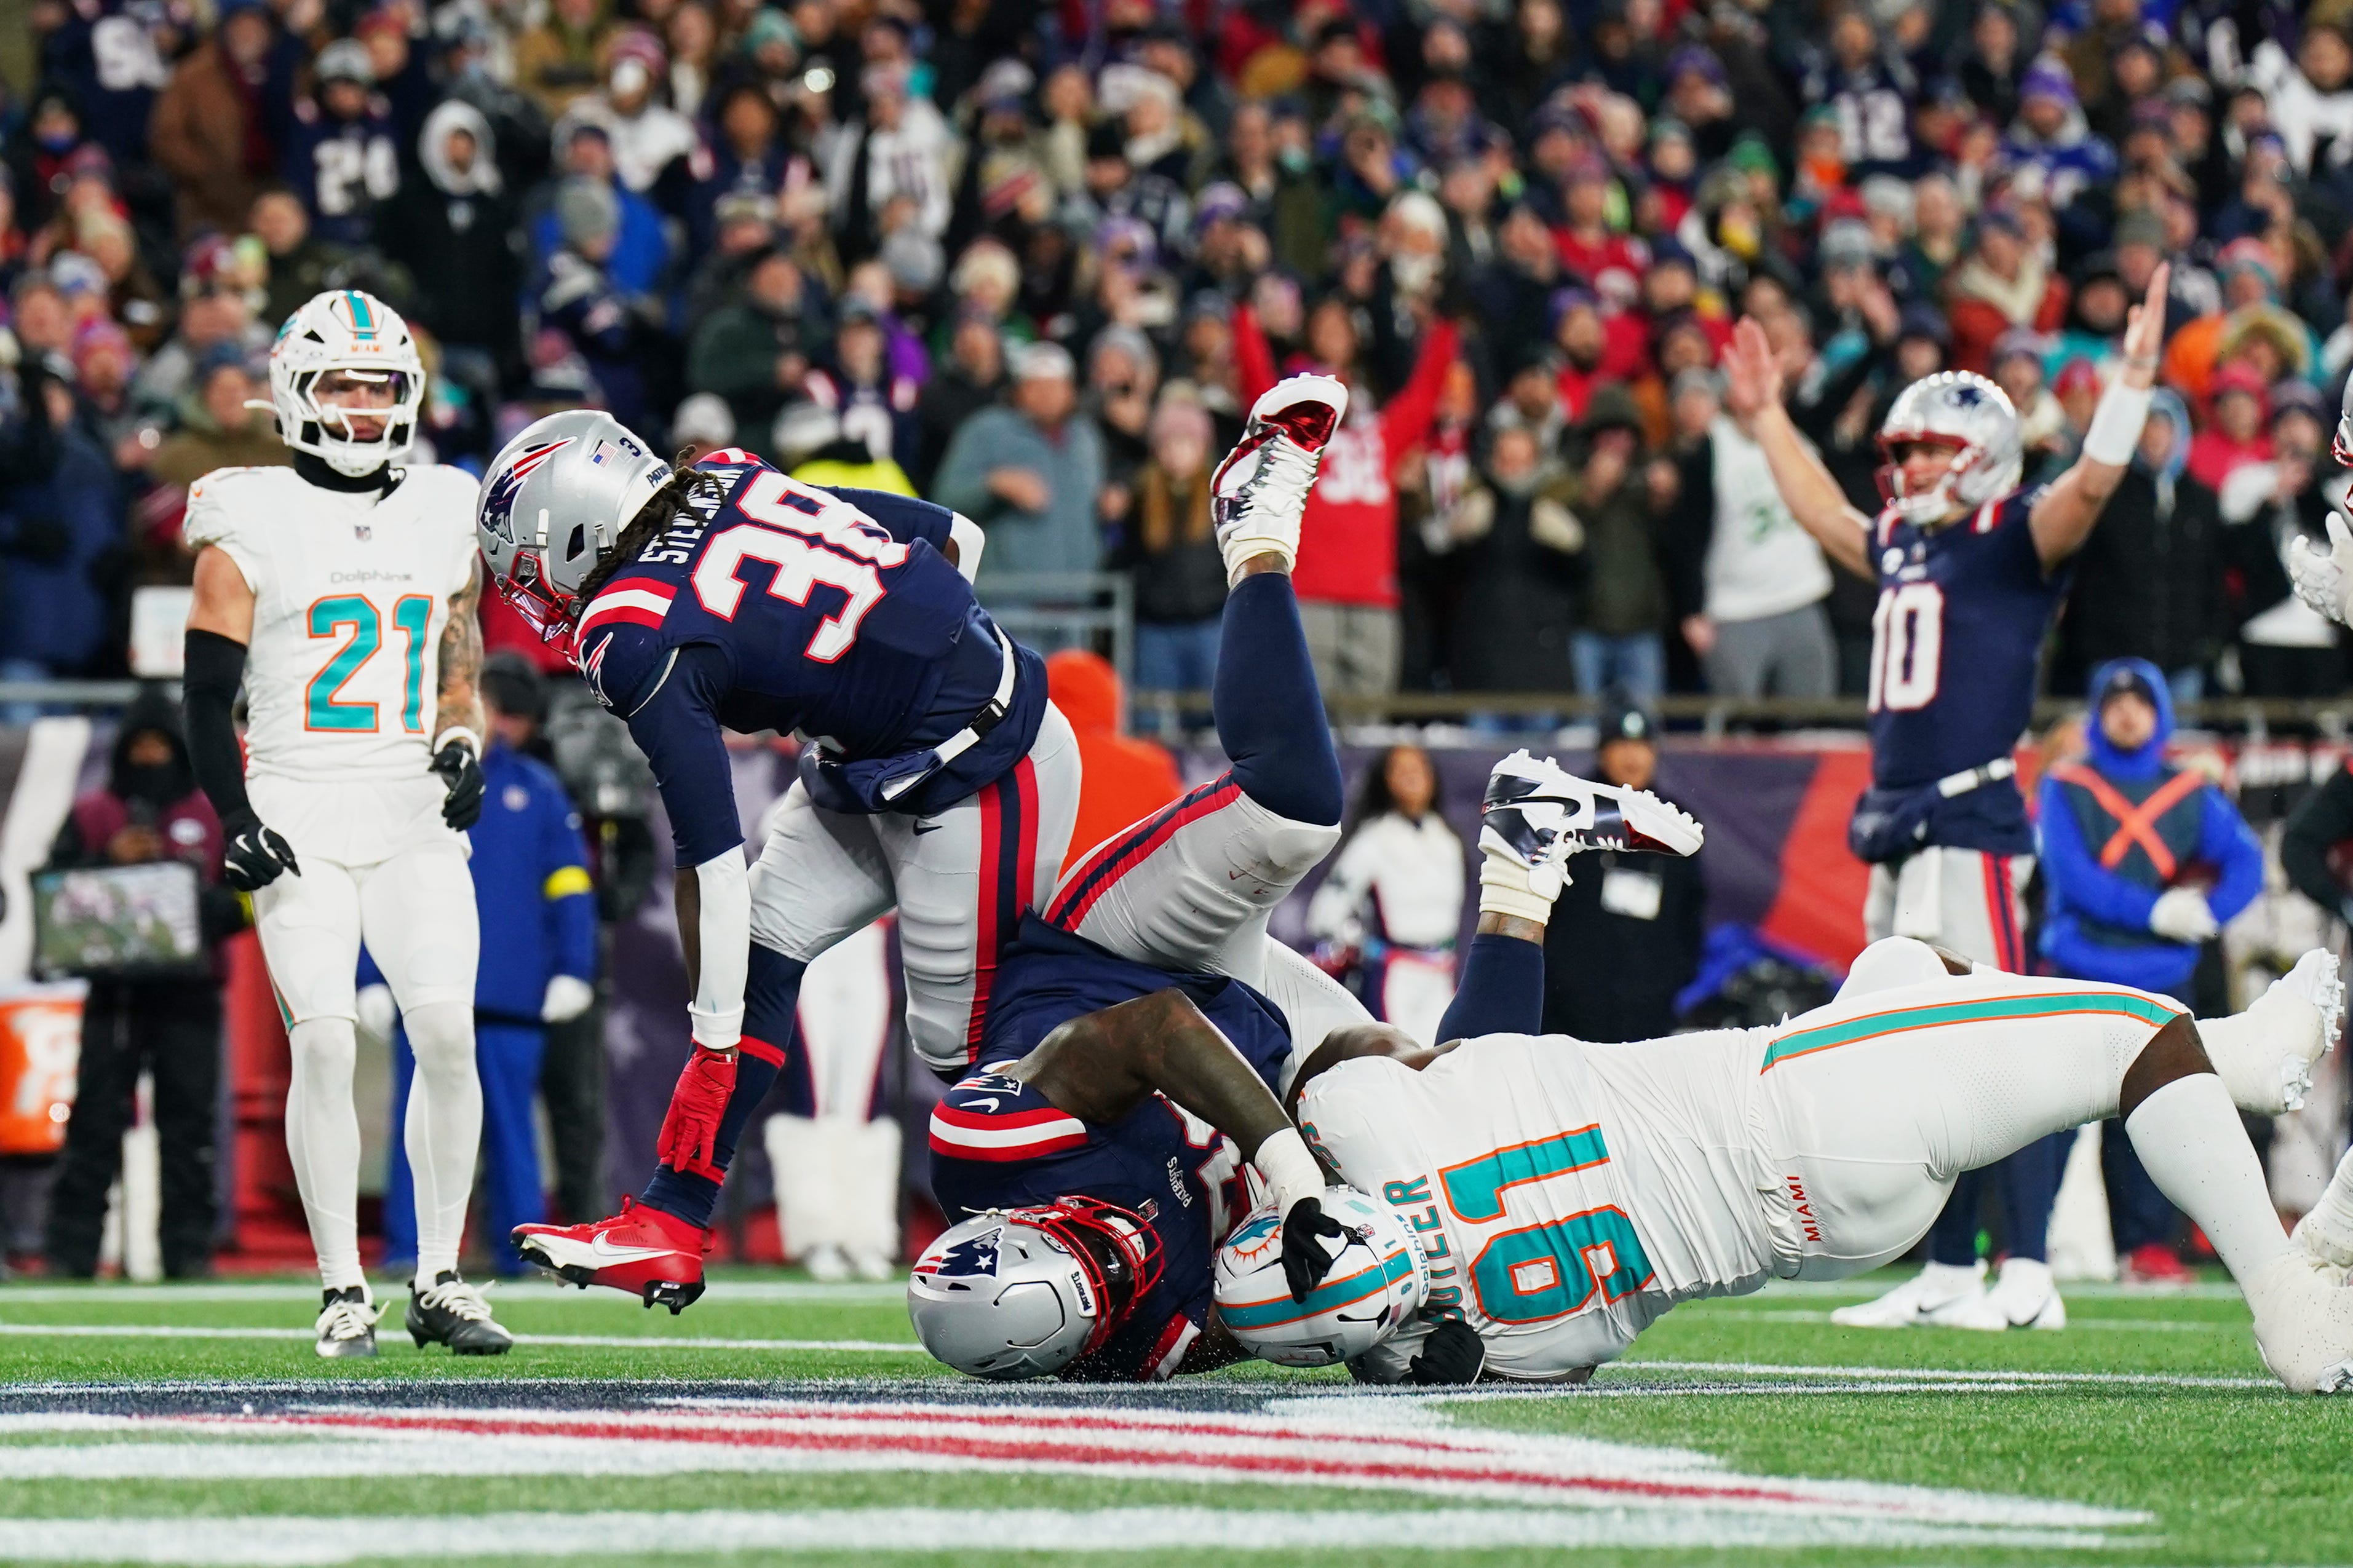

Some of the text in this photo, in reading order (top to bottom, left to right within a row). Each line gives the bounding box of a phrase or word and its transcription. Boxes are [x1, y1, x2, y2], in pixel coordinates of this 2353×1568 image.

[330, 569, 413, 584] Dolphins
[690, 470, 910, 663] 38
[304, 593, 434, 734] 21
[1867, 581, 1945, 714] 10
[1167, 1156, 1193, 1208] PATRIOTS
[1787, 1176, 1821, 1241] MIAMI
[1394, 1214, 1430, 1295] Dolphins
